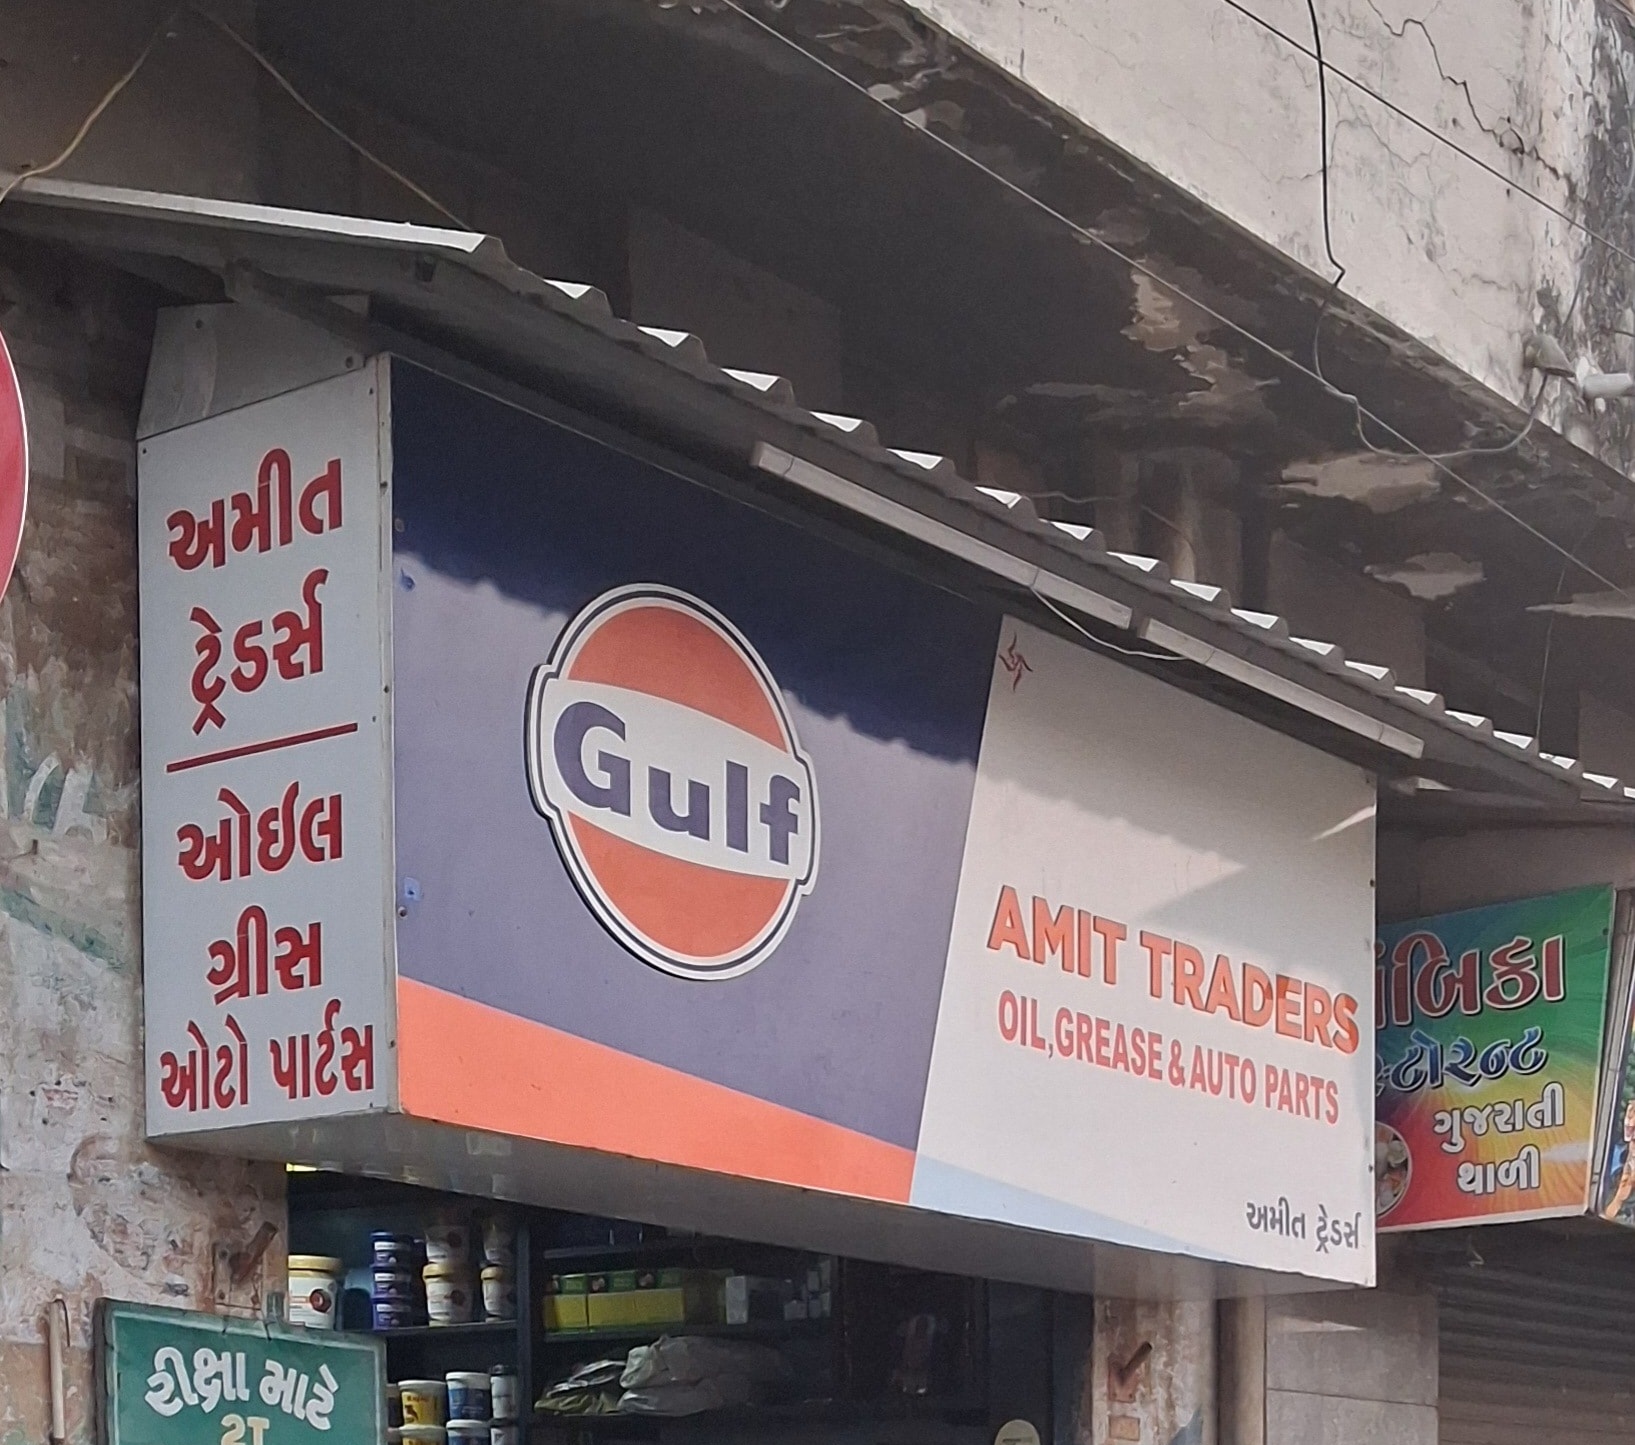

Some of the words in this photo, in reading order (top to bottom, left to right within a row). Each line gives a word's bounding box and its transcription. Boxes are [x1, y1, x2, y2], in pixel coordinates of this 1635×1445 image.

[166, 447, 343, 570] અમીત
[189, 567, 329, 737] ટ્રેડર્સ
[176, 780, 343, 882] ઓઈલ
[553, 700, 801, 866] Gulf
[206, 904, 322, 1006] ગ્રીસ
[986, 884, 1128, 985] AMIT
[1139, 929, 1361, 1055] TRADERS
[159, 1013, 249, 1113] ઓટો
[268, 998, 374, 1100] પાર્ટસ
[1189, 1044, 1257, 1104] AUTO
[1264, 1063, 1339, 1125] PARTS
[1432, 1080, 1566, 1155] ગુજરાતી
[1456, 1143, 1542, 1196] થાળી
[1245, 1196, 1306, 1240] અમીત
[1315, 1203, 1362, 1254] ટ્રેડર્સ
[144, 1345, 251, 1418] રીક્ષા
[259, 1363, 340, 1431] માટે
